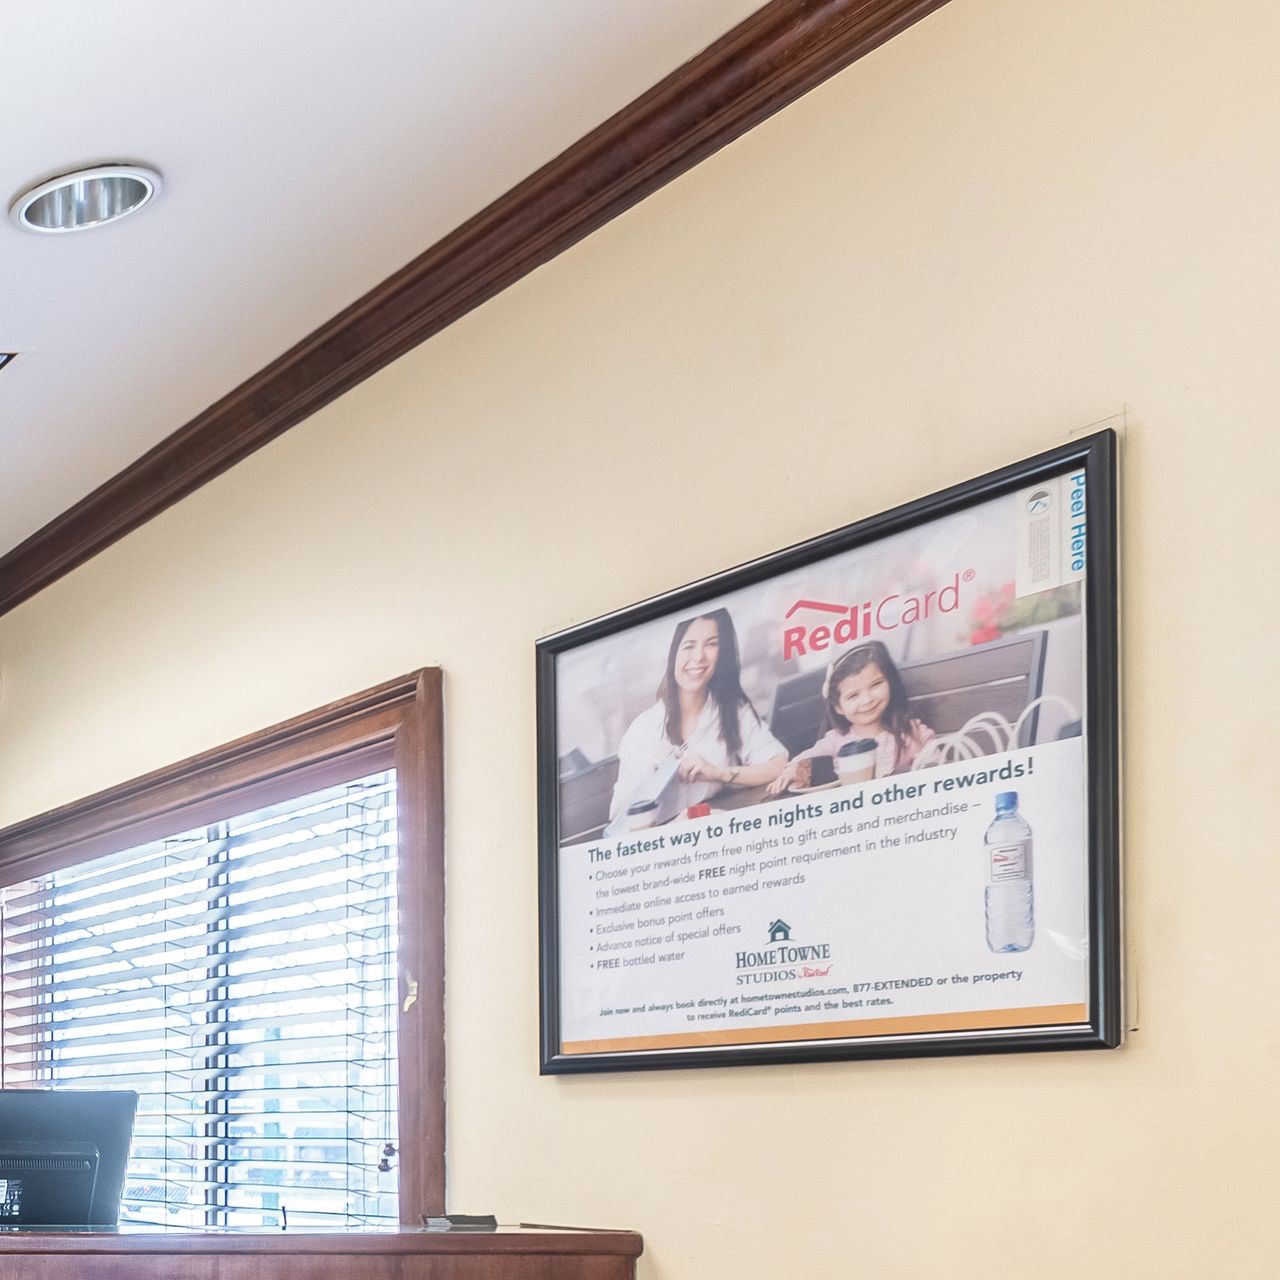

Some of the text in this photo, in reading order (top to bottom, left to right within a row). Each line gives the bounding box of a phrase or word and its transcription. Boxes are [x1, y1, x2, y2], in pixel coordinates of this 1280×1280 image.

[1071, 472, 1086, 571] Peel Here
[588, 757, 1033, 863] The fastest way to free nights and other rewards!
[595, 803, 968, 881] Choose your rewards from free nights to gift cards and merchandise
[596, 827, 957, 899] the lowest brand-wide FREE night point requirement in the industry
[596, 872, 805, 917] Immediate online access to earned rewards
[596, 907, 724, 935] Exclusive bonus point offers
[596, 923, 741, 952] Advance notice of special offers
[597, 951, 686, 970] FREE bottled water
[736, 970, 796, 985] STUDIOS
[633, 1004, 645, 1012] and
[648, 1002, 673, 1012] always
[676, 1001, 694, 1009] book
[698, 998, 727, 1007] directly
[730, 996, 738, 1004] at
[937, 977, 948, 985] or
[952, 974, 968, 984] the
[973, 970, 1022, 984] property
[698, 1011, 726, 1020] receive
[774, 1004, 801, 1016] points
[805, 1002, 820, 1011] and
[824, 1000, 838, 1009] the
[842, 999, 862, 1008] best
[866, 997, 894, 1006] rates.
